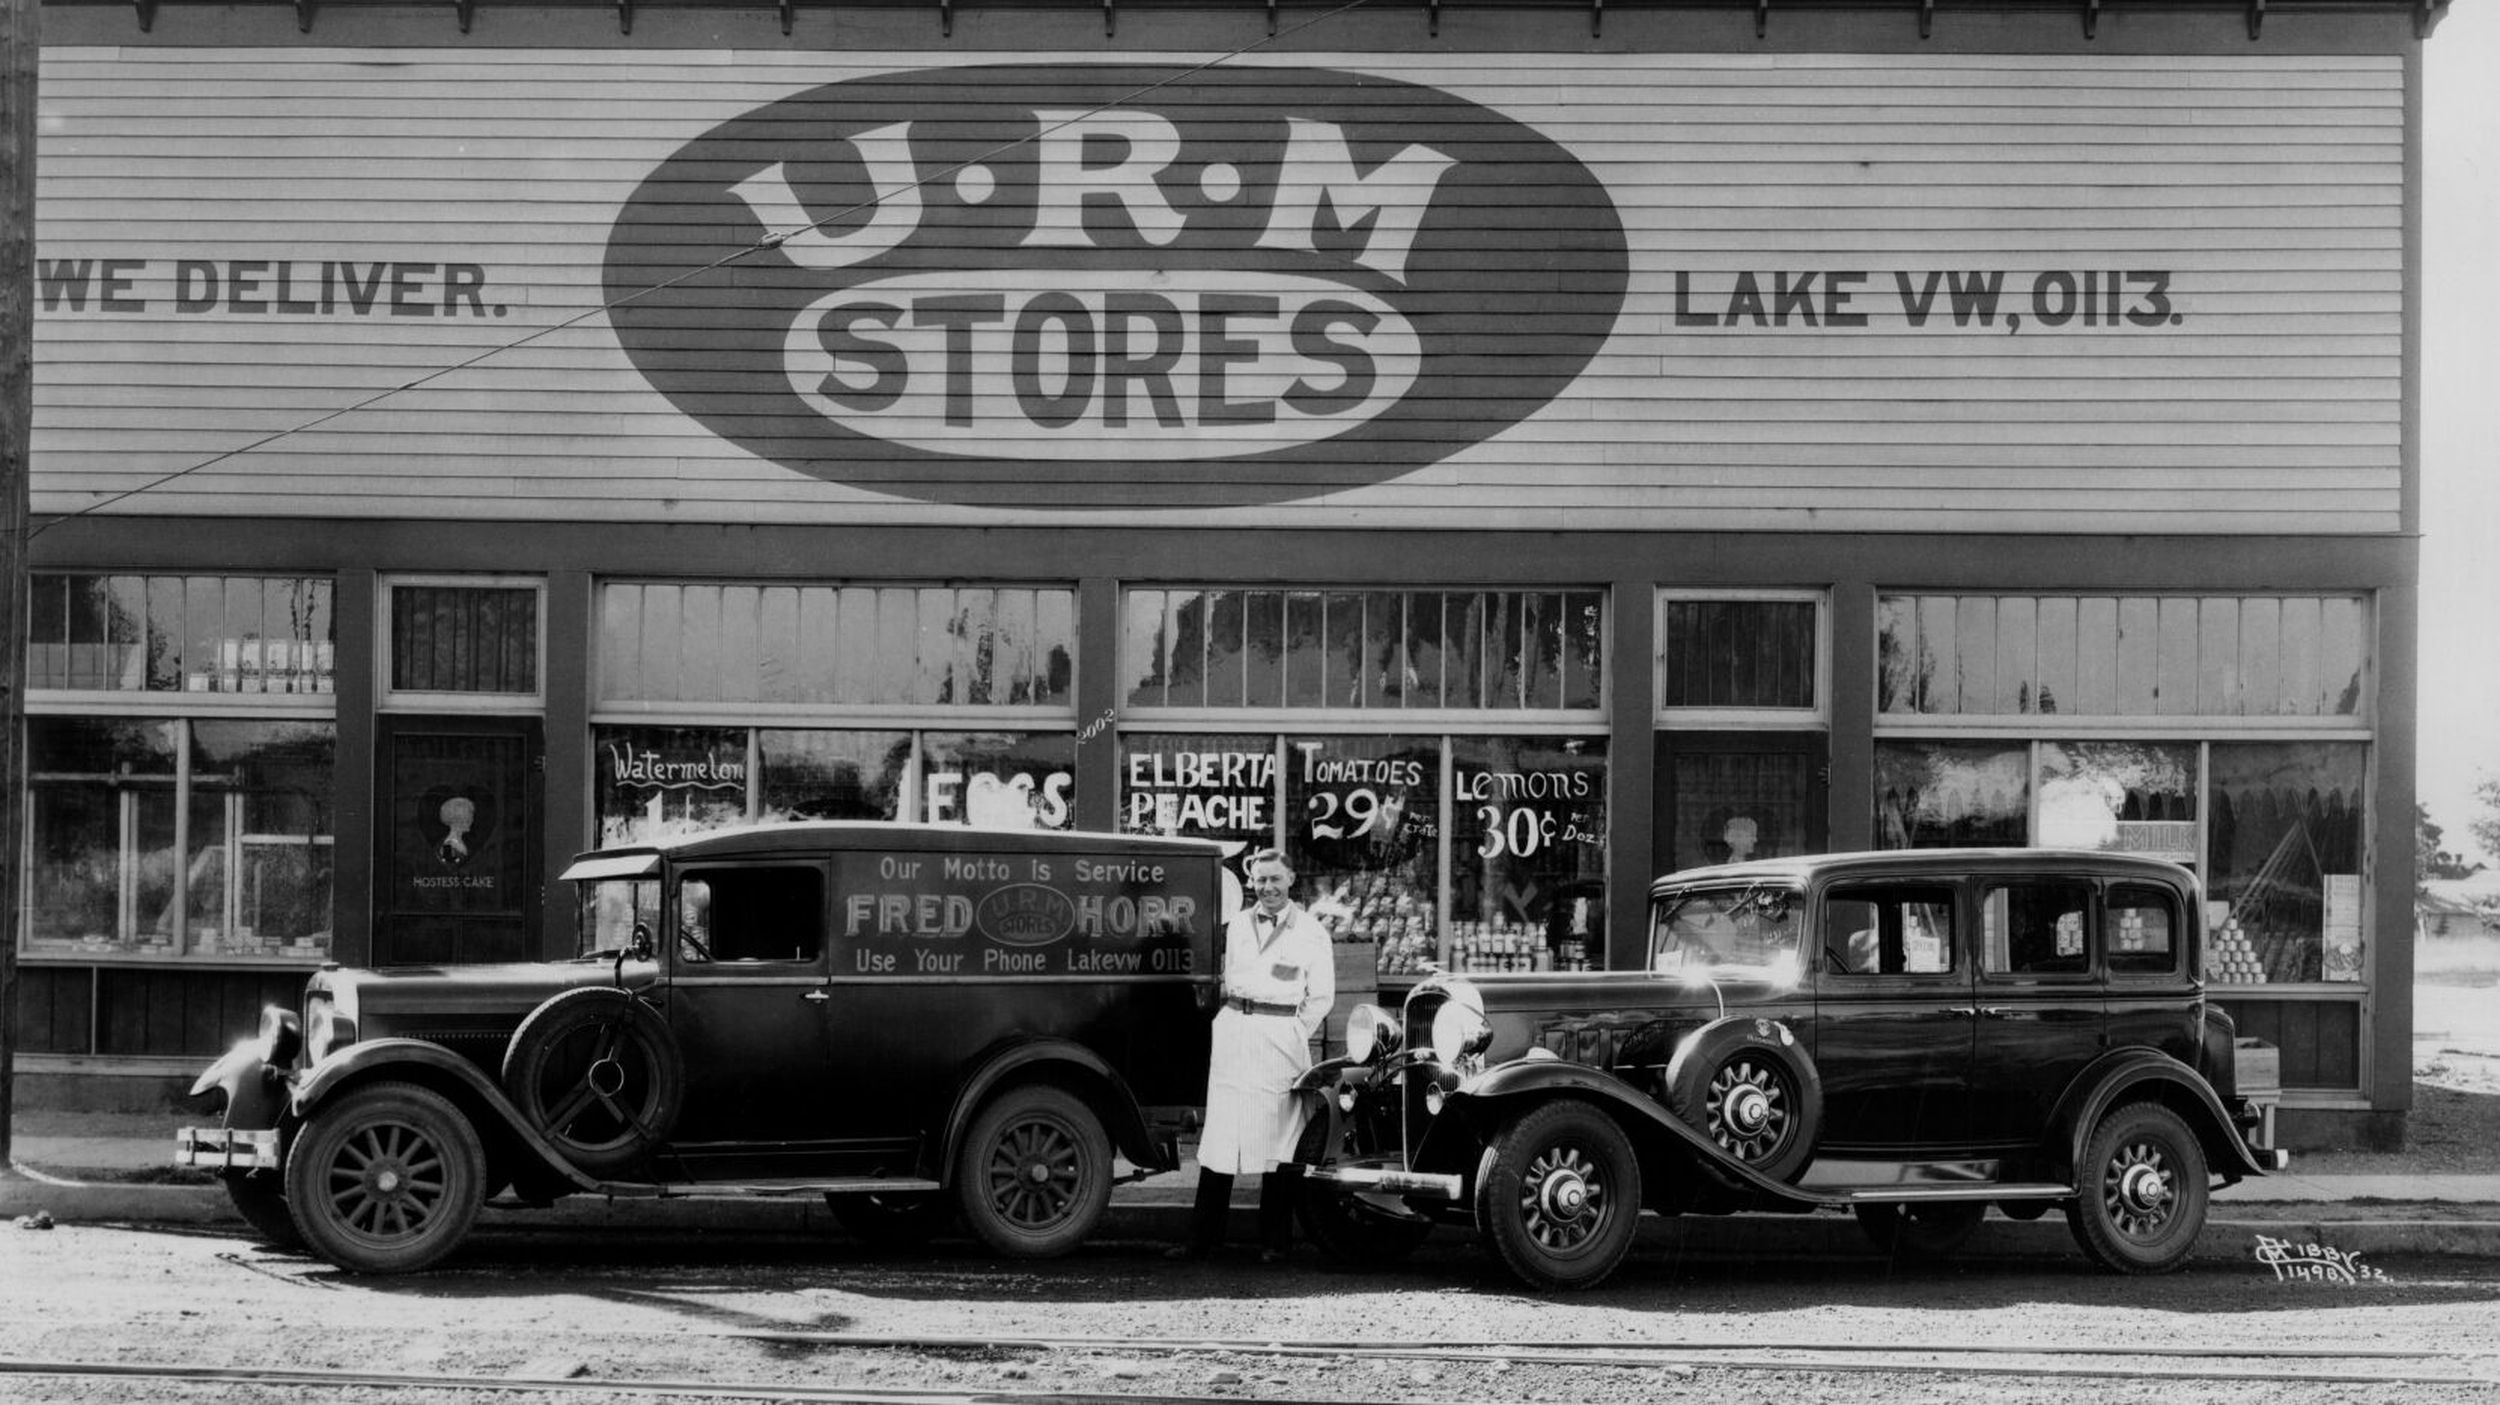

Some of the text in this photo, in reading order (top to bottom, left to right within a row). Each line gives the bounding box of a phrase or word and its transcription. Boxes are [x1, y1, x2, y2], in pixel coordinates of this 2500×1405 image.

[37, 258, 508, 318] WE DELIVER.
[1674, 270, 1869, 327] LAKE
[816, 291, 1382, 428] STORES
[1076, 708, 1115, 745] 2002
[608, 741, 745, 782] Watermelon
[1129, 752, 1275, 788] ELBERTA
[1476, 805, 1558, 859] 30¢
[2122, 826, 2195, 850] MILK
[413, 876, 495, 888] HOSTESS CAKE
[880, 856, 921, 879] Our
[944, 857, 1010, 880] Motto
[1075, 859, 1165, 881] Service
[845, 894, 1195, 938] FRED HORR
[1003, 915, 1054, 934] STORES
[856, 948, 1194, 972] Use Your Phone Lakevw 0113
